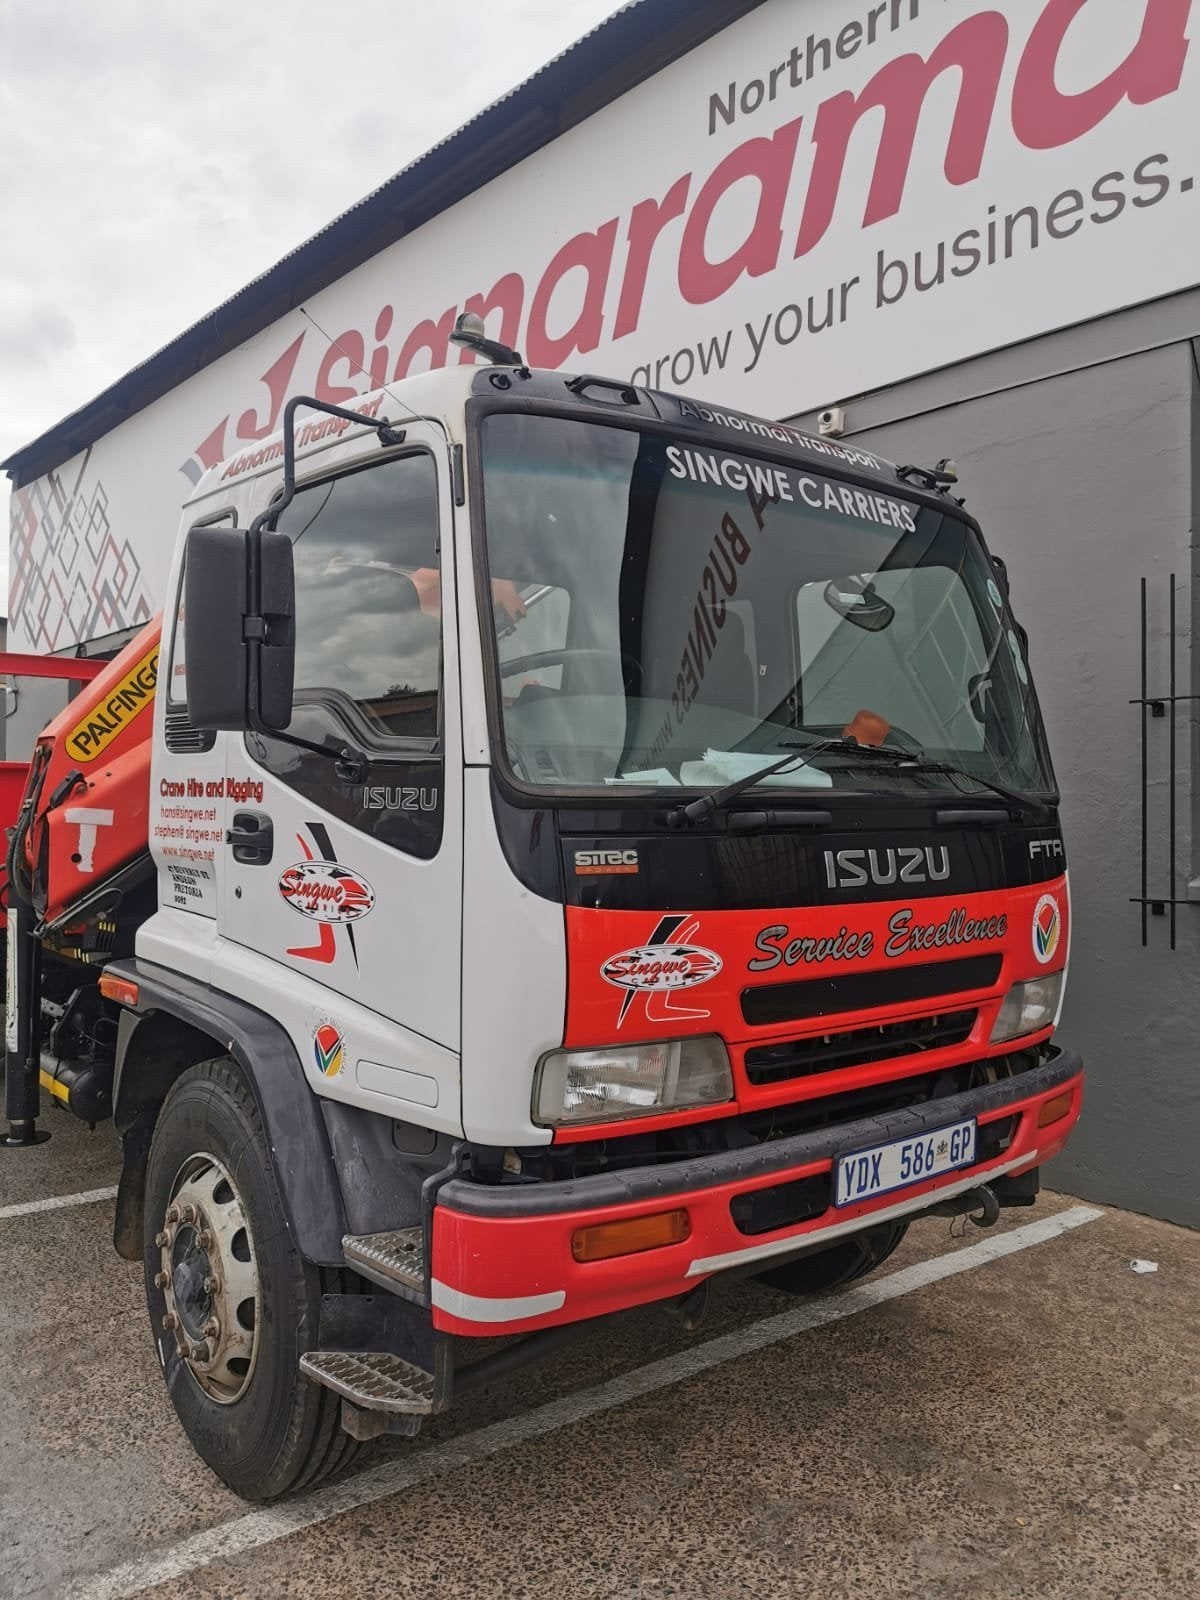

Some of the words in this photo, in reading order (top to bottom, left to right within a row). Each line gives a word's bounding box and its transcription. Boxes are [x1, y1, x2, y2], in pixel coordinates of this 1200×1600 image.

[743, 275, 860, 373] your
[875, 152, 1194, 308] business.
[221, 427, 300, 481] Abnorml
[298, 392, 386, 448] Transprt
[680, 400, 794, 445] Abnormal
[795, 430, 881, 470] Transport
[665, 445, 794, 502] SINGWE
[798, 477, 917, 533] CARRIERS
[160, 778, 185, 798] Crane
[187, 778, 204, 798] Hire
[205, 777, 224, 798] and
[226, 777, 264, 803] Rigging
[363, 786, 438, 811] ISUZU
[823, 846, 951, 888] ISUZU
[1029, 839, 1063, 859] FTR
[174, 883, 203, 899] PRETORIA
[280, 869, 343, 908] Singwe
[748, 924, 874, 971] Service
[885, 907, 1008, 957] Excellence
[607, 955, 689, 982] Singwe
[845, 1152, 882, 1197] YDX
[900, 1137, 935, 1180] 586
[950, 1126, 971, 1163] GP
